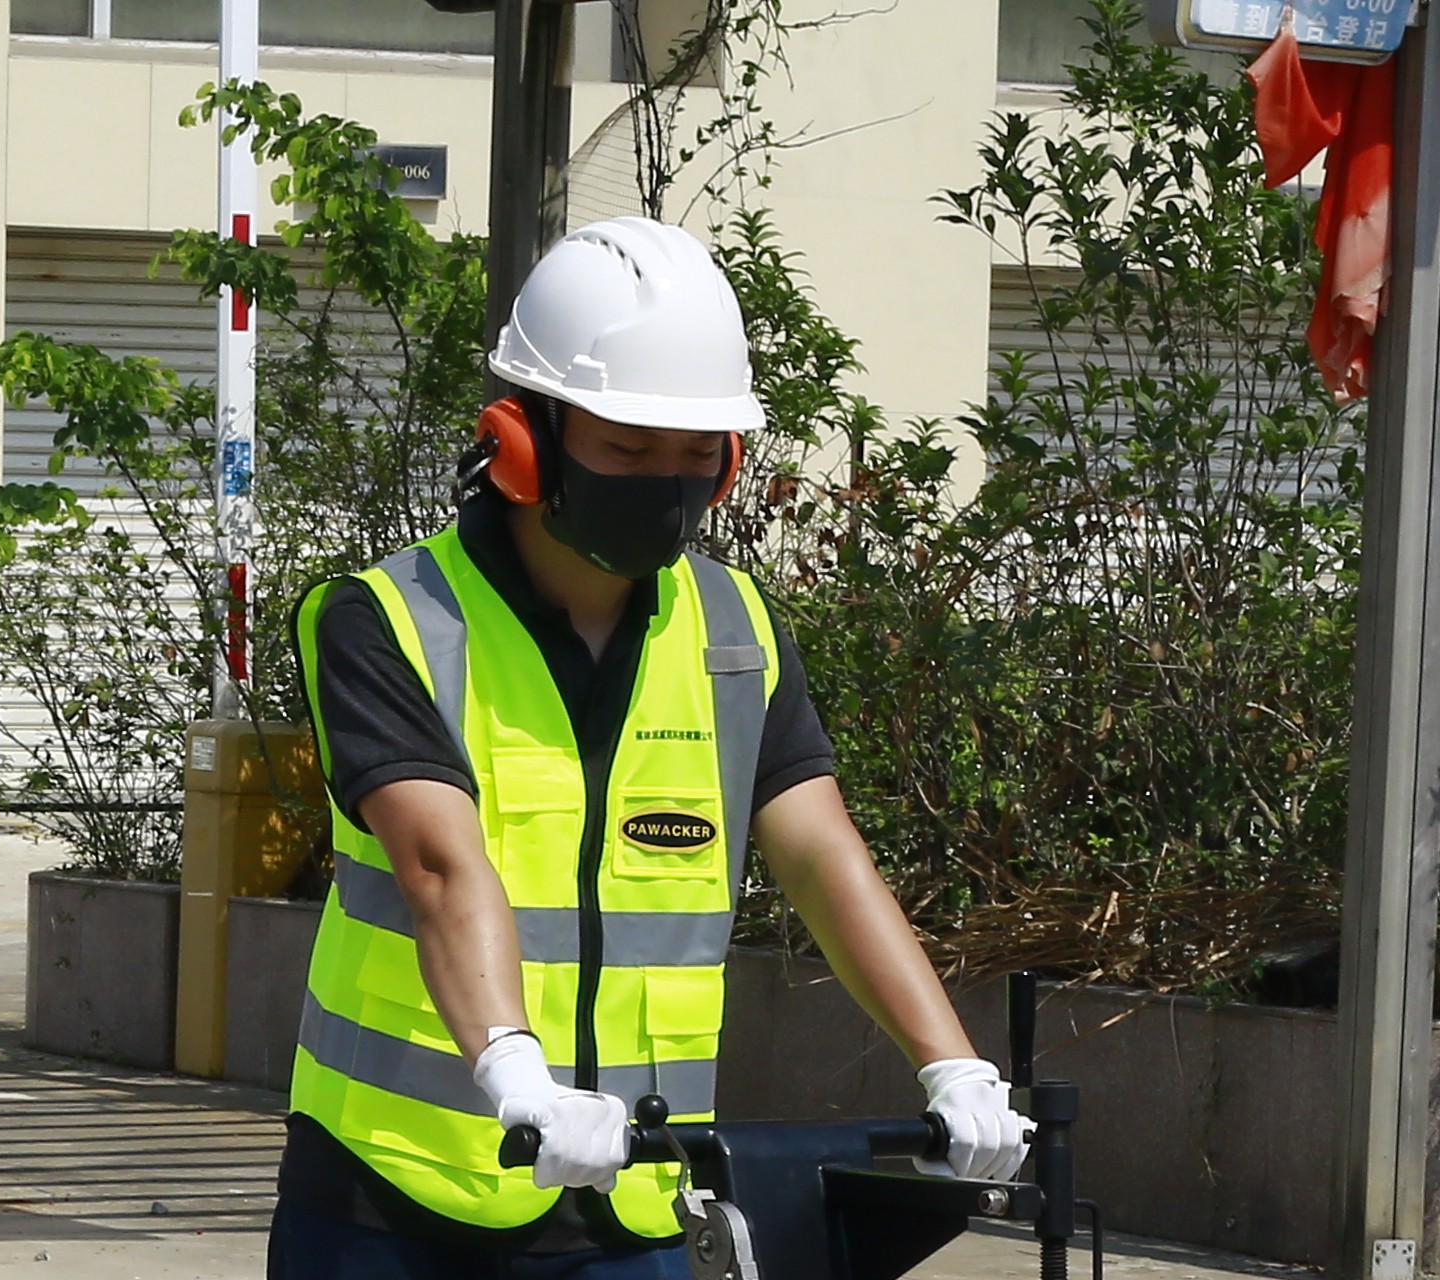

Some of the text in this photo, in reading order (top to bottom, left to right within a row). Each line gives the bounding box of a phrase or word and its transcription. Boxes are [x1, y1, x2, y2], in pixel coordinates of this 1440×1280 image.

[1215, 2, 1388, 47] 请到台登记
[628, 823, 711, 838] PAWACKER
